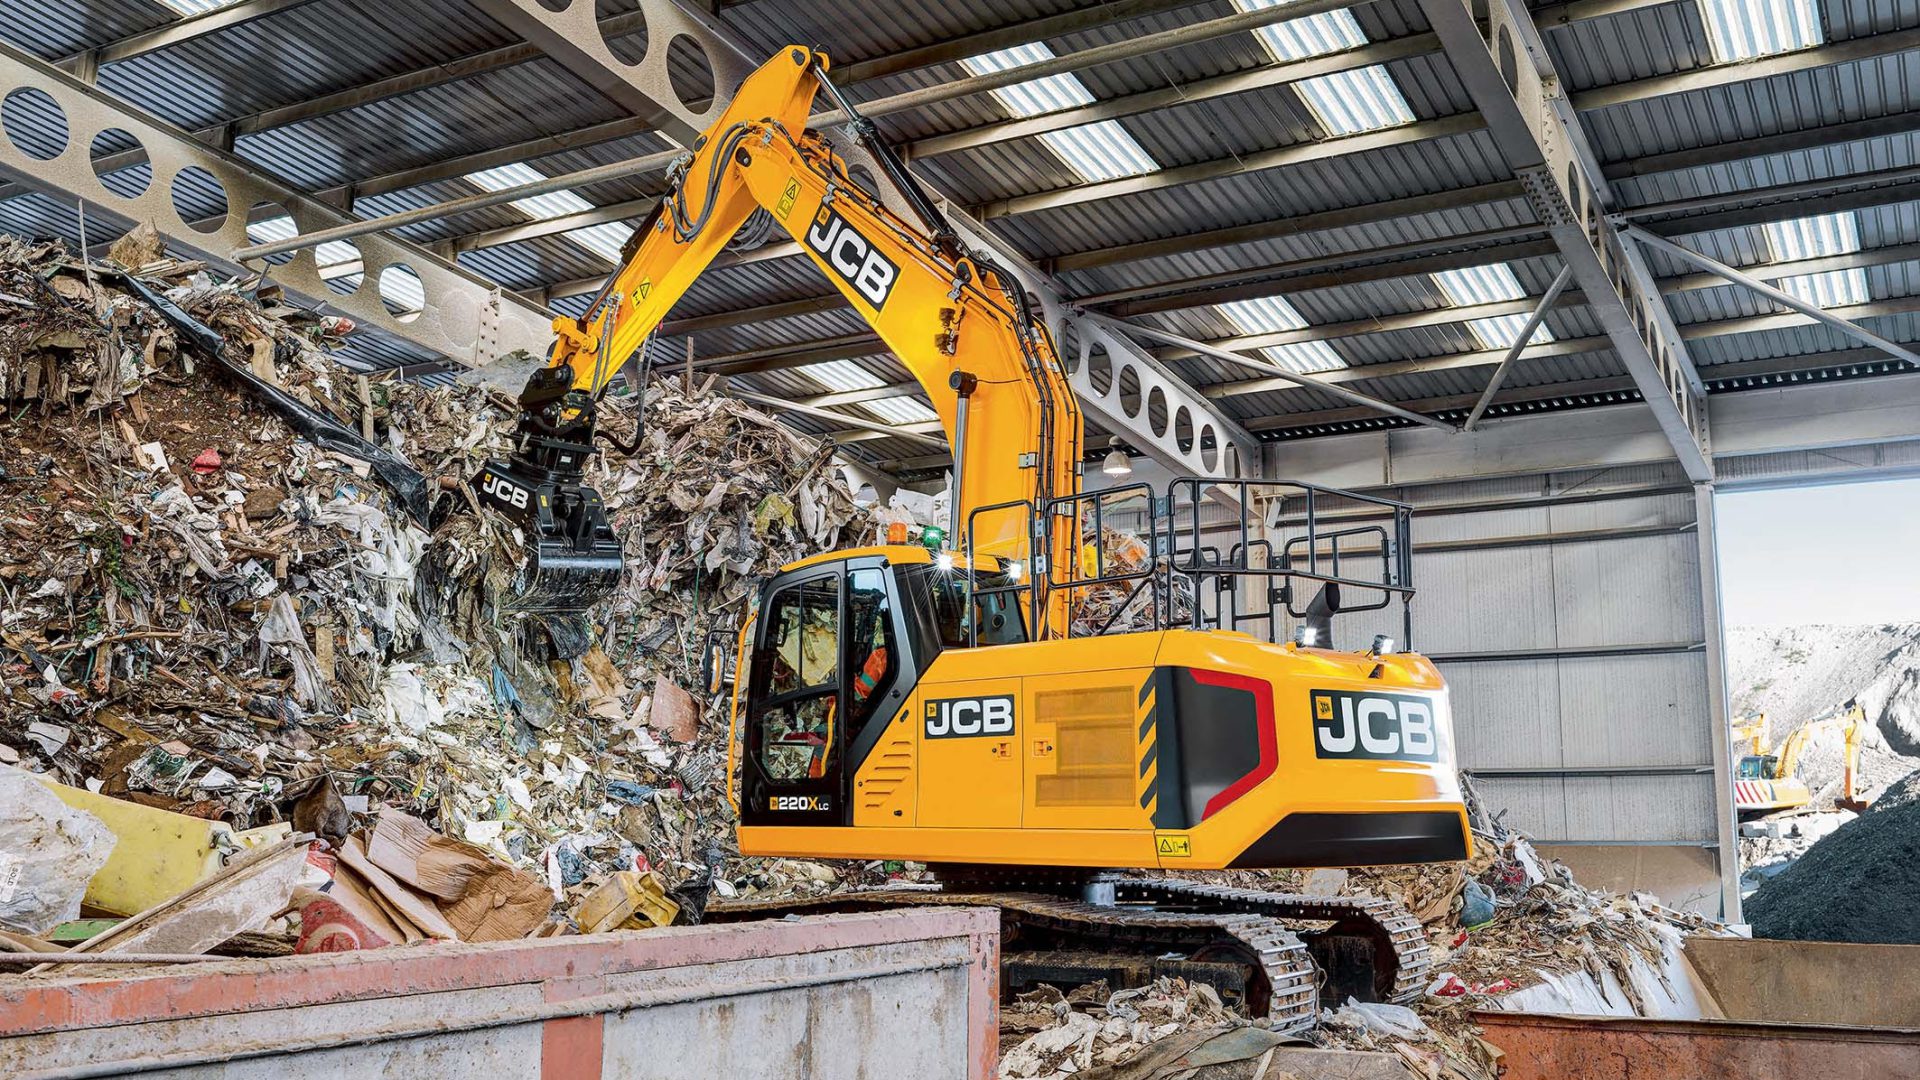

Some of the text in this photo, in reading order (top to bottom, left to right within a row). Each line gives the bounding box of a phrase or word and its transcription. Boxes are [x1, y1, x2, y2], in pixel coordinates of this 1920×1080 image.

[809, 217, 894, 304] JCB
[482, 475, 529, 510] JCB
[926, 698, 1013, 736] JCB
[1318, 697, 1435, 756] JCB
